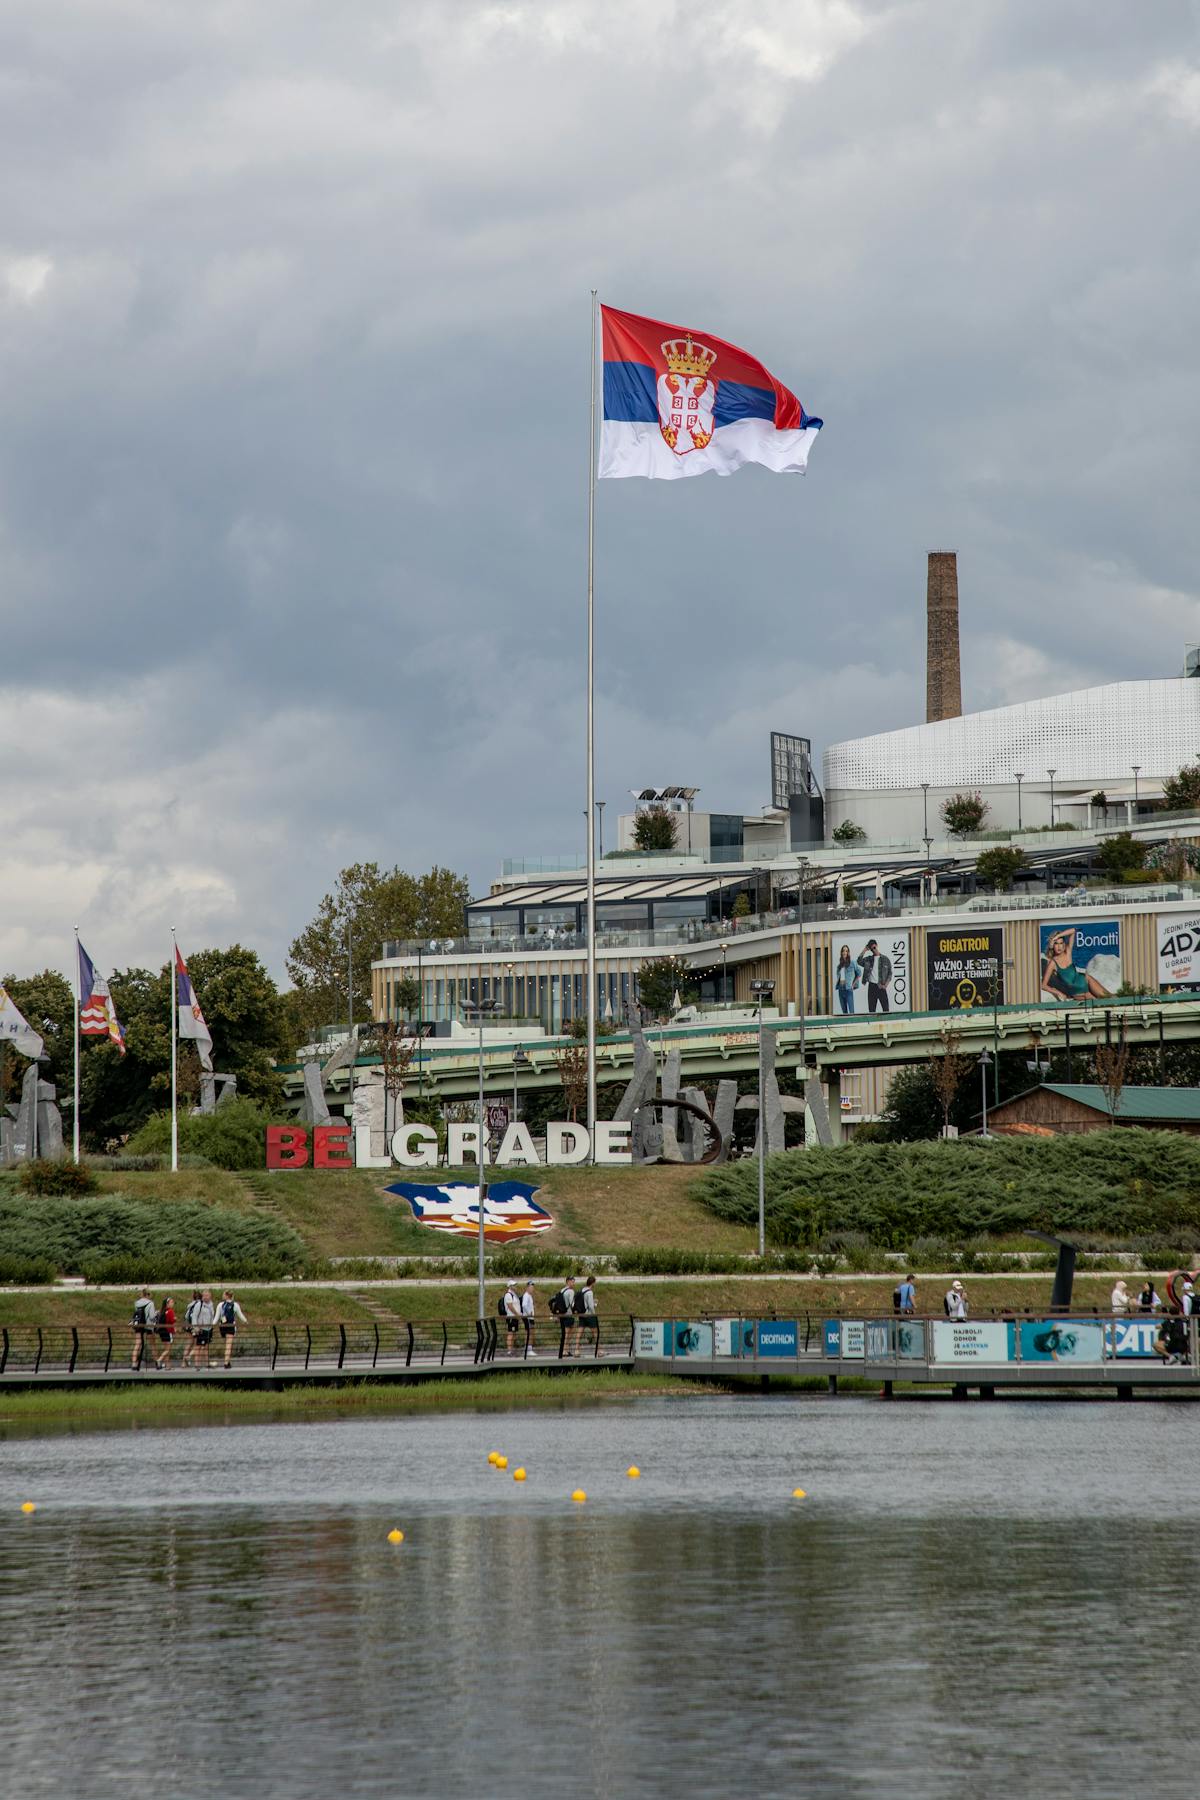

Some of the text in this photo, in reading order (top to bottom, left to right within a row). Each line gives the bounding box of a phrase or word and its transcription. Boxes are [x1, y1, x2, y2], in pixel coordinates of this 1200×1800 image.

[1163, 923, 1183, 935] JEDINI
[940, 937, 990, 953] GIGATRON
[1076, 931, 1119, 947] Bonatti
[934, 958, 963, 972] VAŽNO
[964, 959, 975, 970] JE
[1171, 956, 1192, 967] GRADU
[892, 940, 906, 1005] COLIN'S
[934, 970, 966, 980] KUPUJETE
[266, 1121, 633, 1168] BELGRADE
[760, 1333, 795, 1345] DECATHLON
